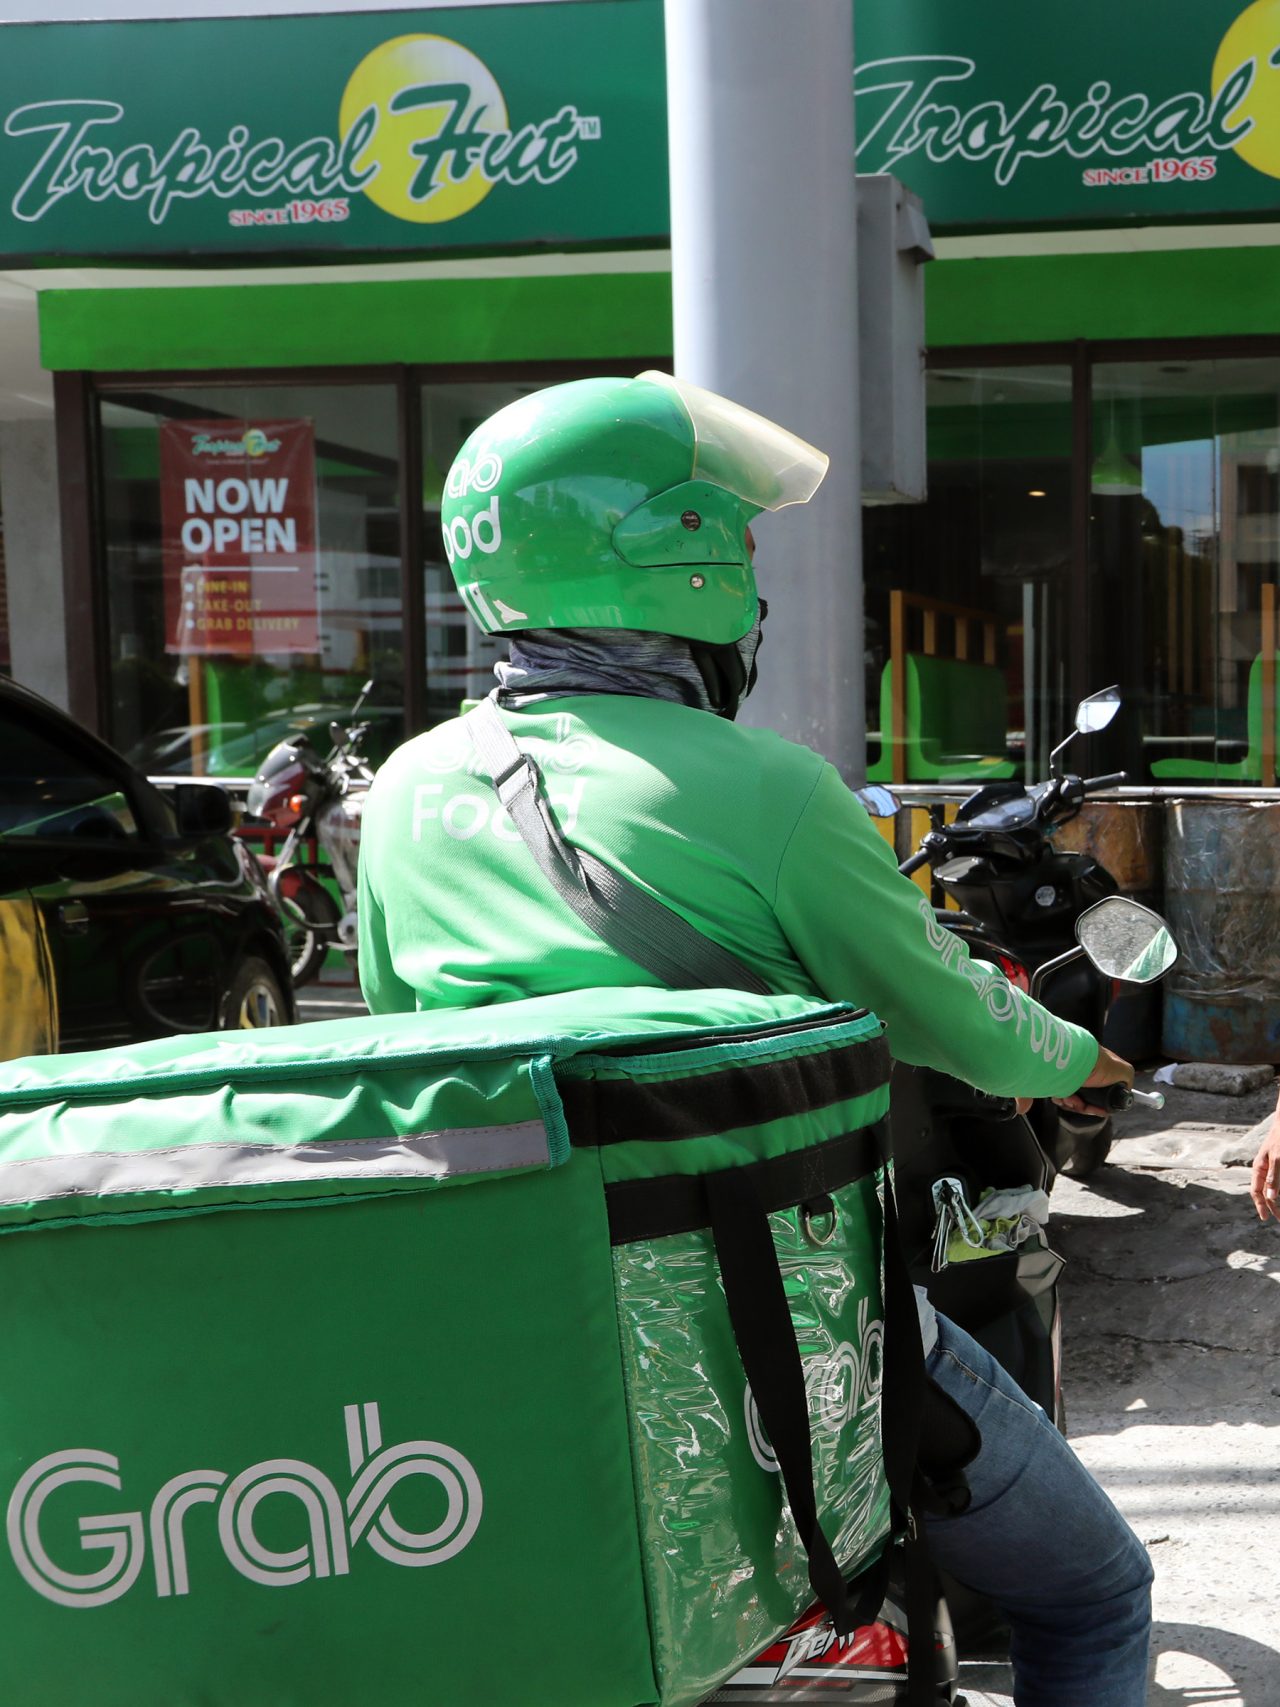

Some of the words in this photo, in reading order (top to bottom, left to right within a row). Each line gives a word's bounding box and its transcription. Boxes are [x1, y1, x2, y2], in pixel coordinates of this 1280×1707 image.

[854, 55, 1256, 186] Tropical
[4, 99, 379, 224] Tropical
[389, 82, 578, 203] Hut
[1082, 167, 1148, 186] SINCE
[1147, 156, 1217, 182] 1965
[229, 208, 287, 226] SINCE
[286, 198, 350, 223] 1965
[184, 478, 288, 514] NOW
[181, 518, 297, 553] OPEN
[442, 495, 502, 564] ood
[197, 599, 263, 613] TAKE-OUT
[196, 617, 233, 632] GRAB
[236, 617, 300, 632] DELIVERY
[6, 1401, 484, 1609] Grab
